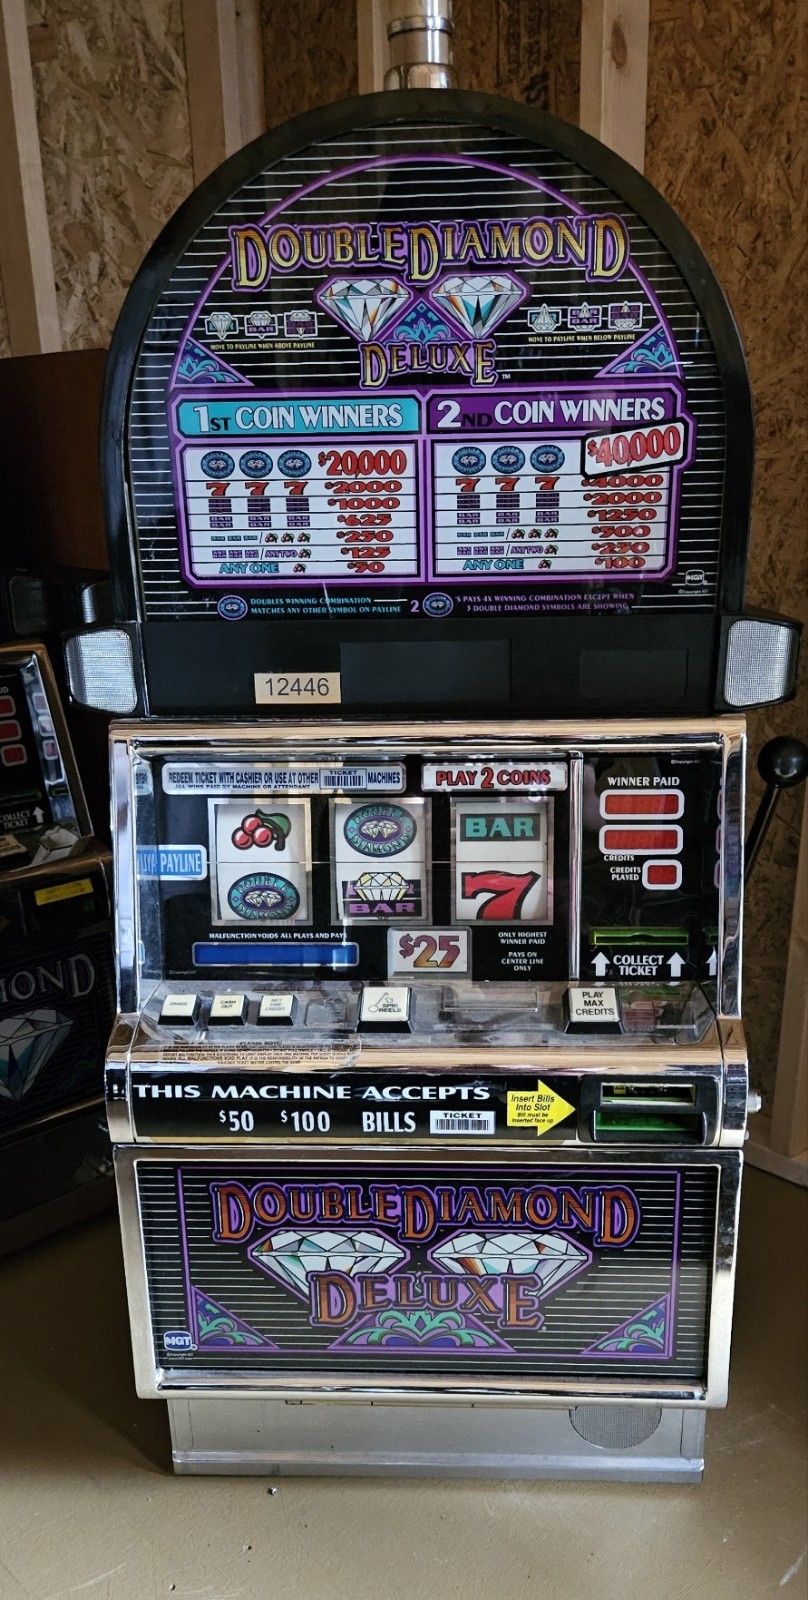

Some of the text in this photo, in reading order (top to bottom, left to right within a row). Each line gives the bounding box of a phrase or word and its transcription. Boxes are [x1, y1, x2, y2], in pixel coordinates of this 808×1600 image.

[362, 341, 496, 388] DELUXE
[193, 403, 403, 432] 1ST COIN WINNERS
[437, 397, 665, 428] 2ND COIN WINNERS
[586, 425, 681, 467] $40,000
[318, 449, 407, 479] $20,000
[206, 480, 403, 496] 7 7 7 $2000
[456, 478, 481, 492] 7
[495, 477, 520, 491] 7
[535, 476, 560, 490] 7
[327, 497, 400, 511] $1000
[583, 492, 662, 505] $2000
[337, 514, 392, 527] $625
[587, 508, 657, 522] $1250
[336, 529, 394, 543] $250
[591, 525, 651, 537] $500
[340, 546, 391, 558] $125
[591, 542, 650, 554] $250
[219, 563, 279, 574] ANY ONE
[347, 562, 385, 573] $50
[462, 559, 524, 570] ANY ONE
[595, 556, 645, 569] $100
[410, 600, 420, 613] 2
[593, 602, 628, 610] SHOWING
[265, 678, 329, 696] 12446
[168, 772, 193, 783] REDEEM
[195, 772, 217, 783] TICKET
[218, 772, 234, 783] WITH
[236, 772, 262, 783] CASHIER
[264, 772, 273, 783] OR
[274, 772, 287, 783] USE
[288, 772, 297, 783] AT
[298, 772, 319, 783] OTHER
[368, 772, 400, 784] MACHINES
[436, 767, 551, 788] PLAY 2 COINS
[607, 776, 680, 787] WINNER PAID
[3, 818, 28, 830] TICKET
[465, 818, 535, 837] BAR
[160, 852, 201, 873] PAYLINE
[611, 873, 640, 881] PLAYED
[461, 870, 542, 920] 7
[349, 902, 416, 913] BAR
[399, 934, 460, 968] $25
[613, 955, 664, 965] COLLECT
[619, 965, 658, 976] TICKET
[575, 1008, 615, 1016] CREDITS
[135, 1085, 491, 1100] THIS MACHINE ACCEPTS
[511, 1095, 555, 1103] Insert Bills
[516, 1103, 550, 1111] Into Slot
[219, 1110, 255, 1132] $50
[280, 1110, 330, 1133] $100
[362, 1111, 416, 1133] BILLS
[313, 1273, 541, 1327] DELUXE
